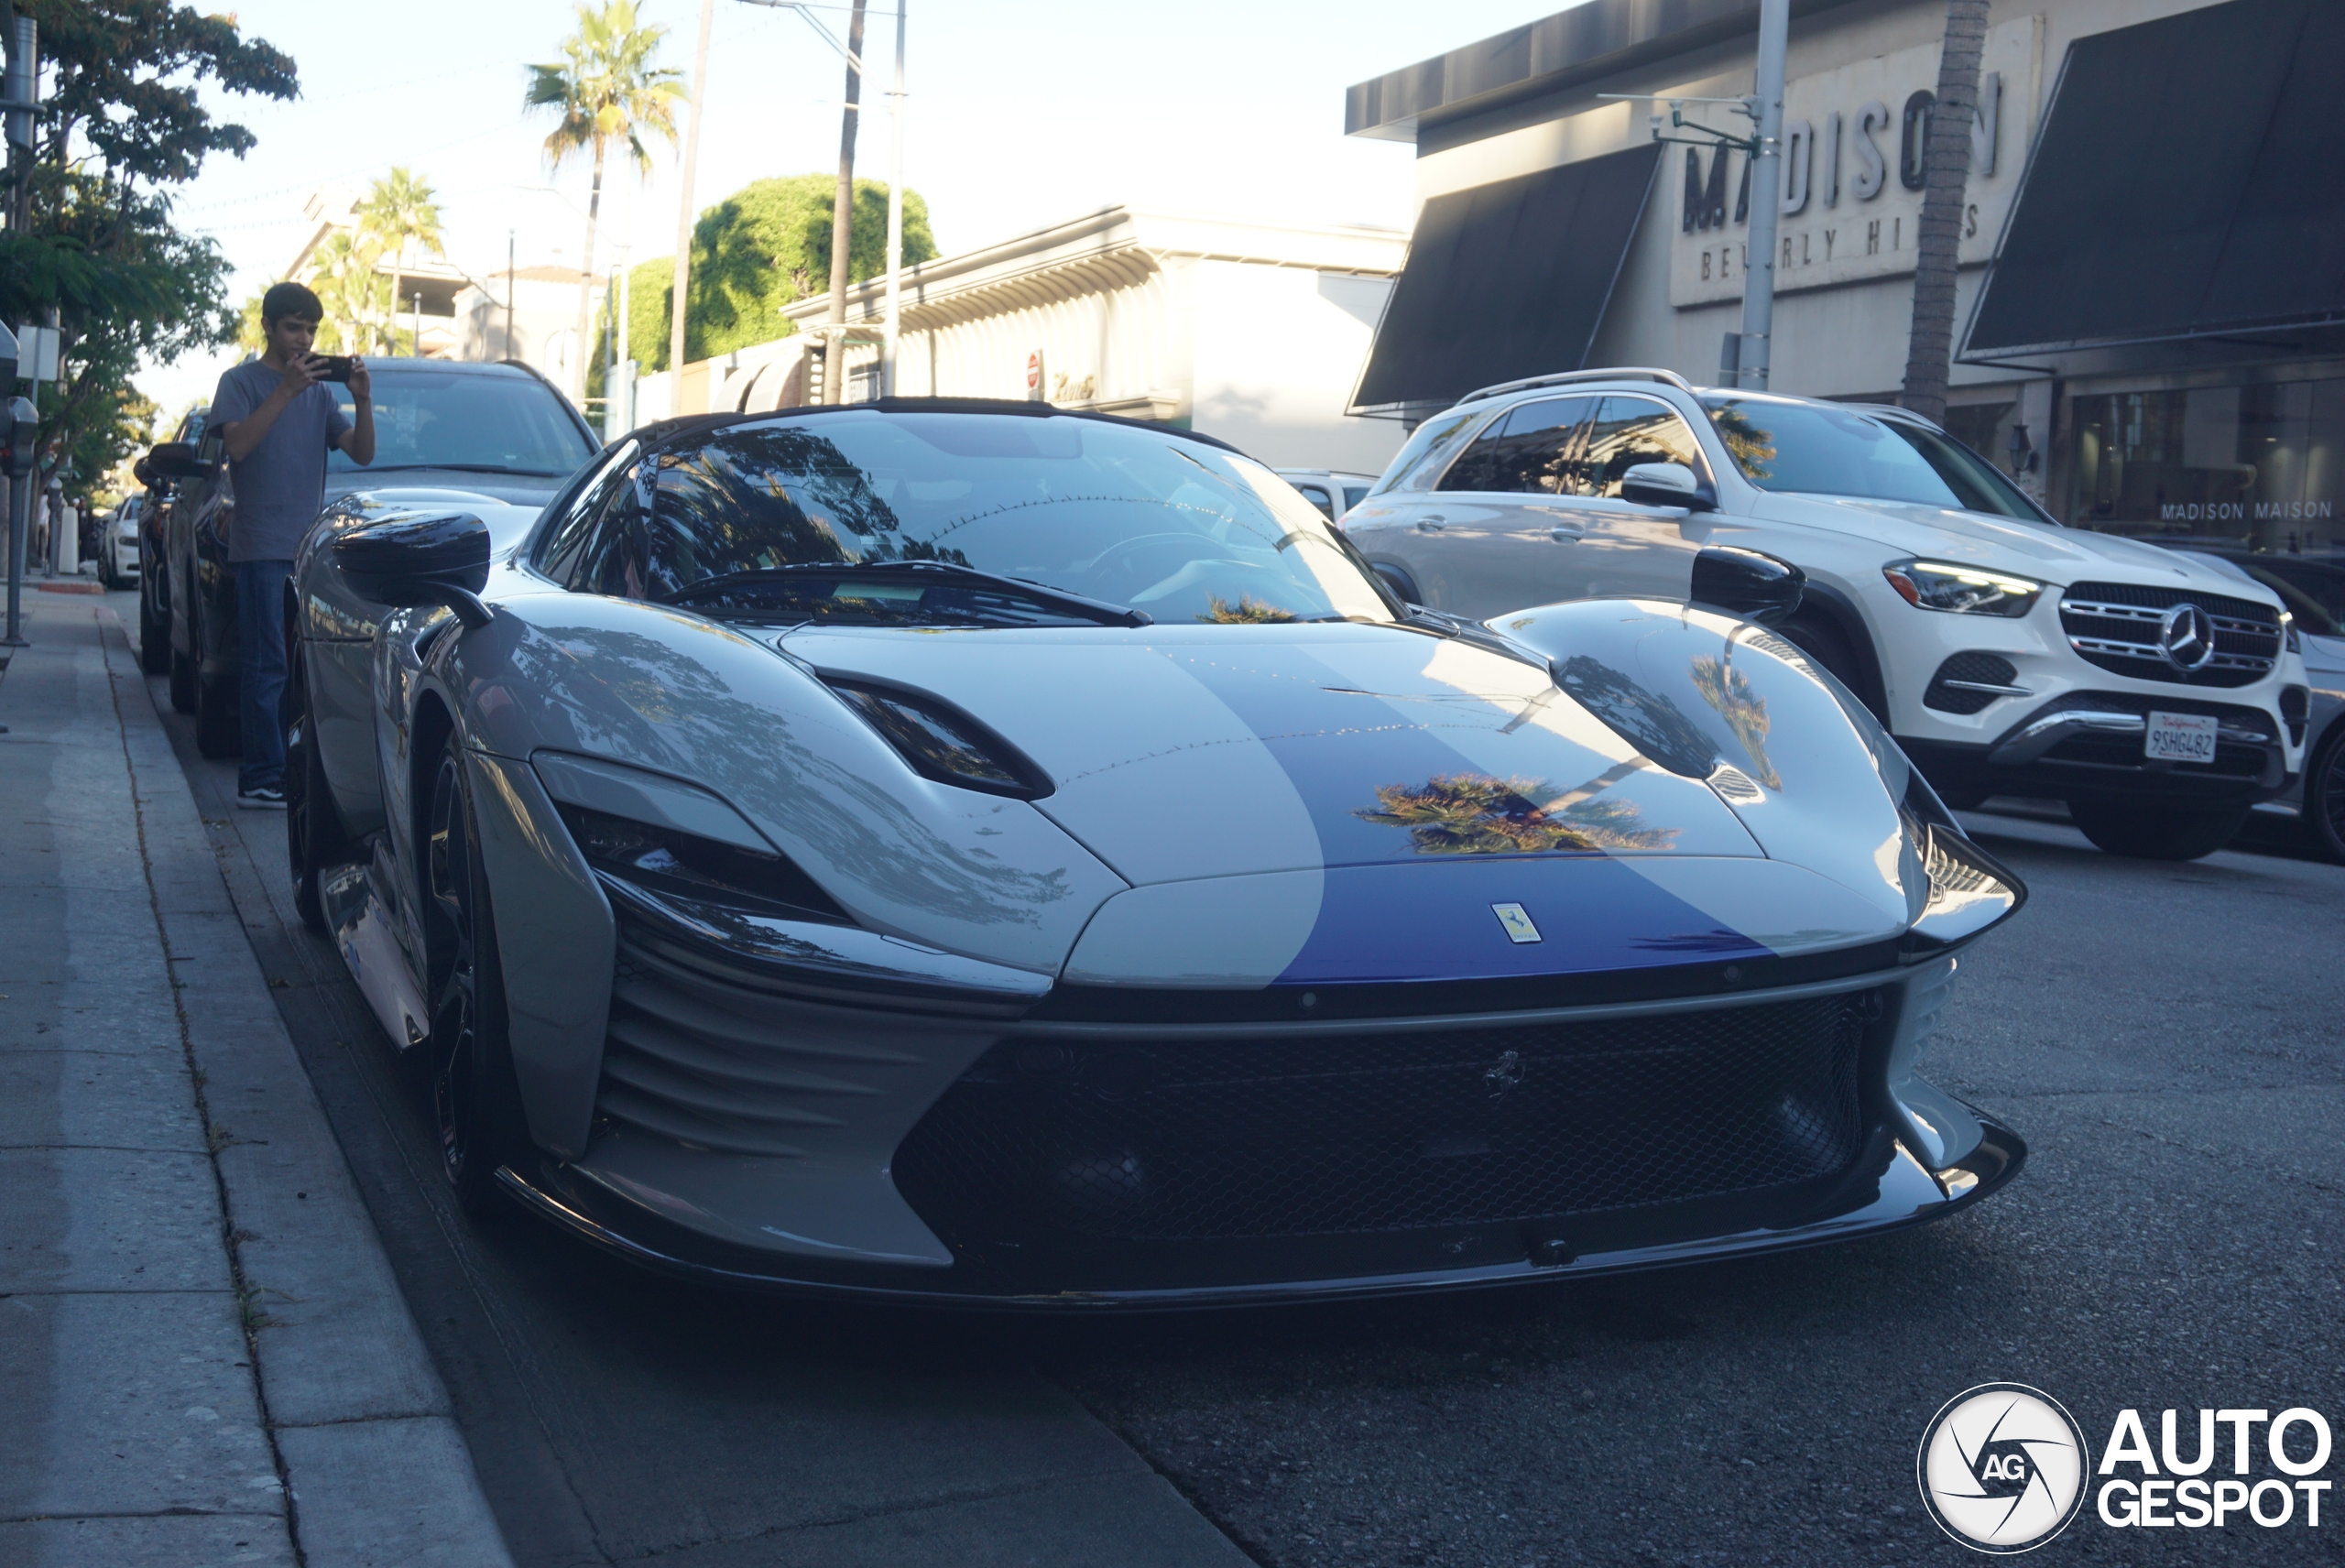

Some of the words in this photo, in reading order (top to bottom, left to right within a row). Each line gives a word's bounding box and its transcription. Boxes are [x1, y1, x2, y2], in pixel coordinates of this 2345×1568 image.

[1701, 230, 1837, 281] BERLY
[1868, 202, 1979, 256] HIS
[2162, 503, 2244, 520] MADISON
[2254, 500, 2332, 519] MAISON
